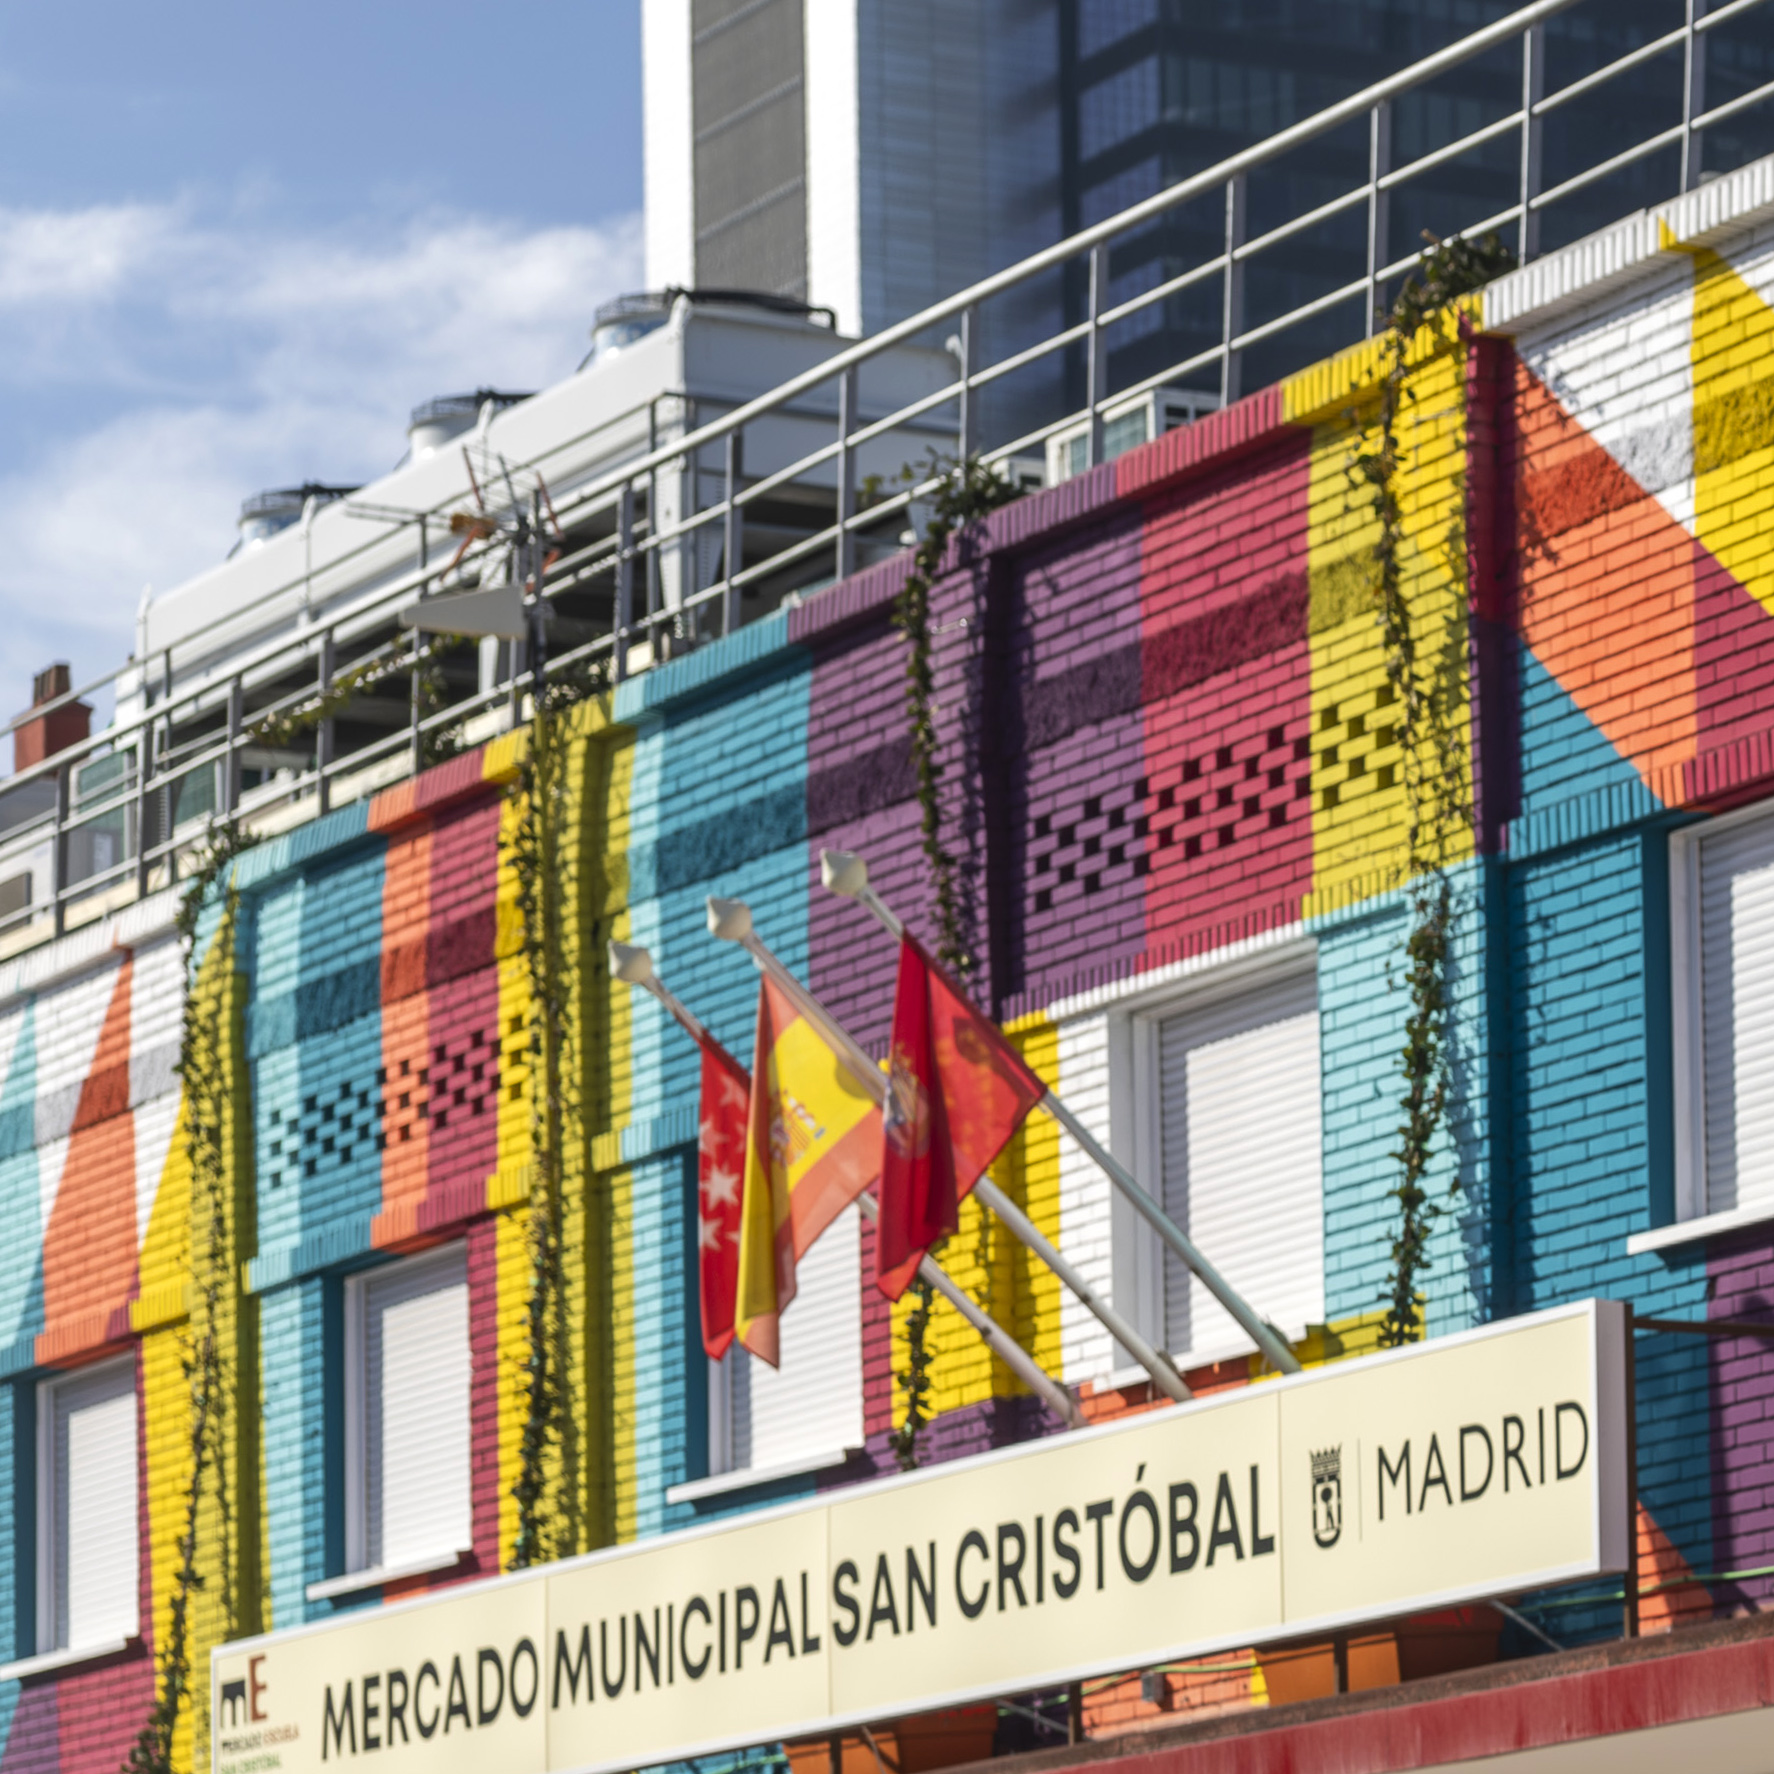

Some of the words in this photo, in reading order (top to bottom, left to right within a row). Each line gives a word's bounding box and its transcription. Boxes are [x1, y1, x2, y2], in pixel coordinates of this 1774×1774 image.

[1377, 1400, 1589, 1521] MADRID
[322, 1636, 540, 1761] MERCADO
[551, 1571, 821, 1709] MUNICIPAL
[832, 1540, 938, 1647] SAN
[955, 1462, 1275, 1620] CRISTÓBAL
